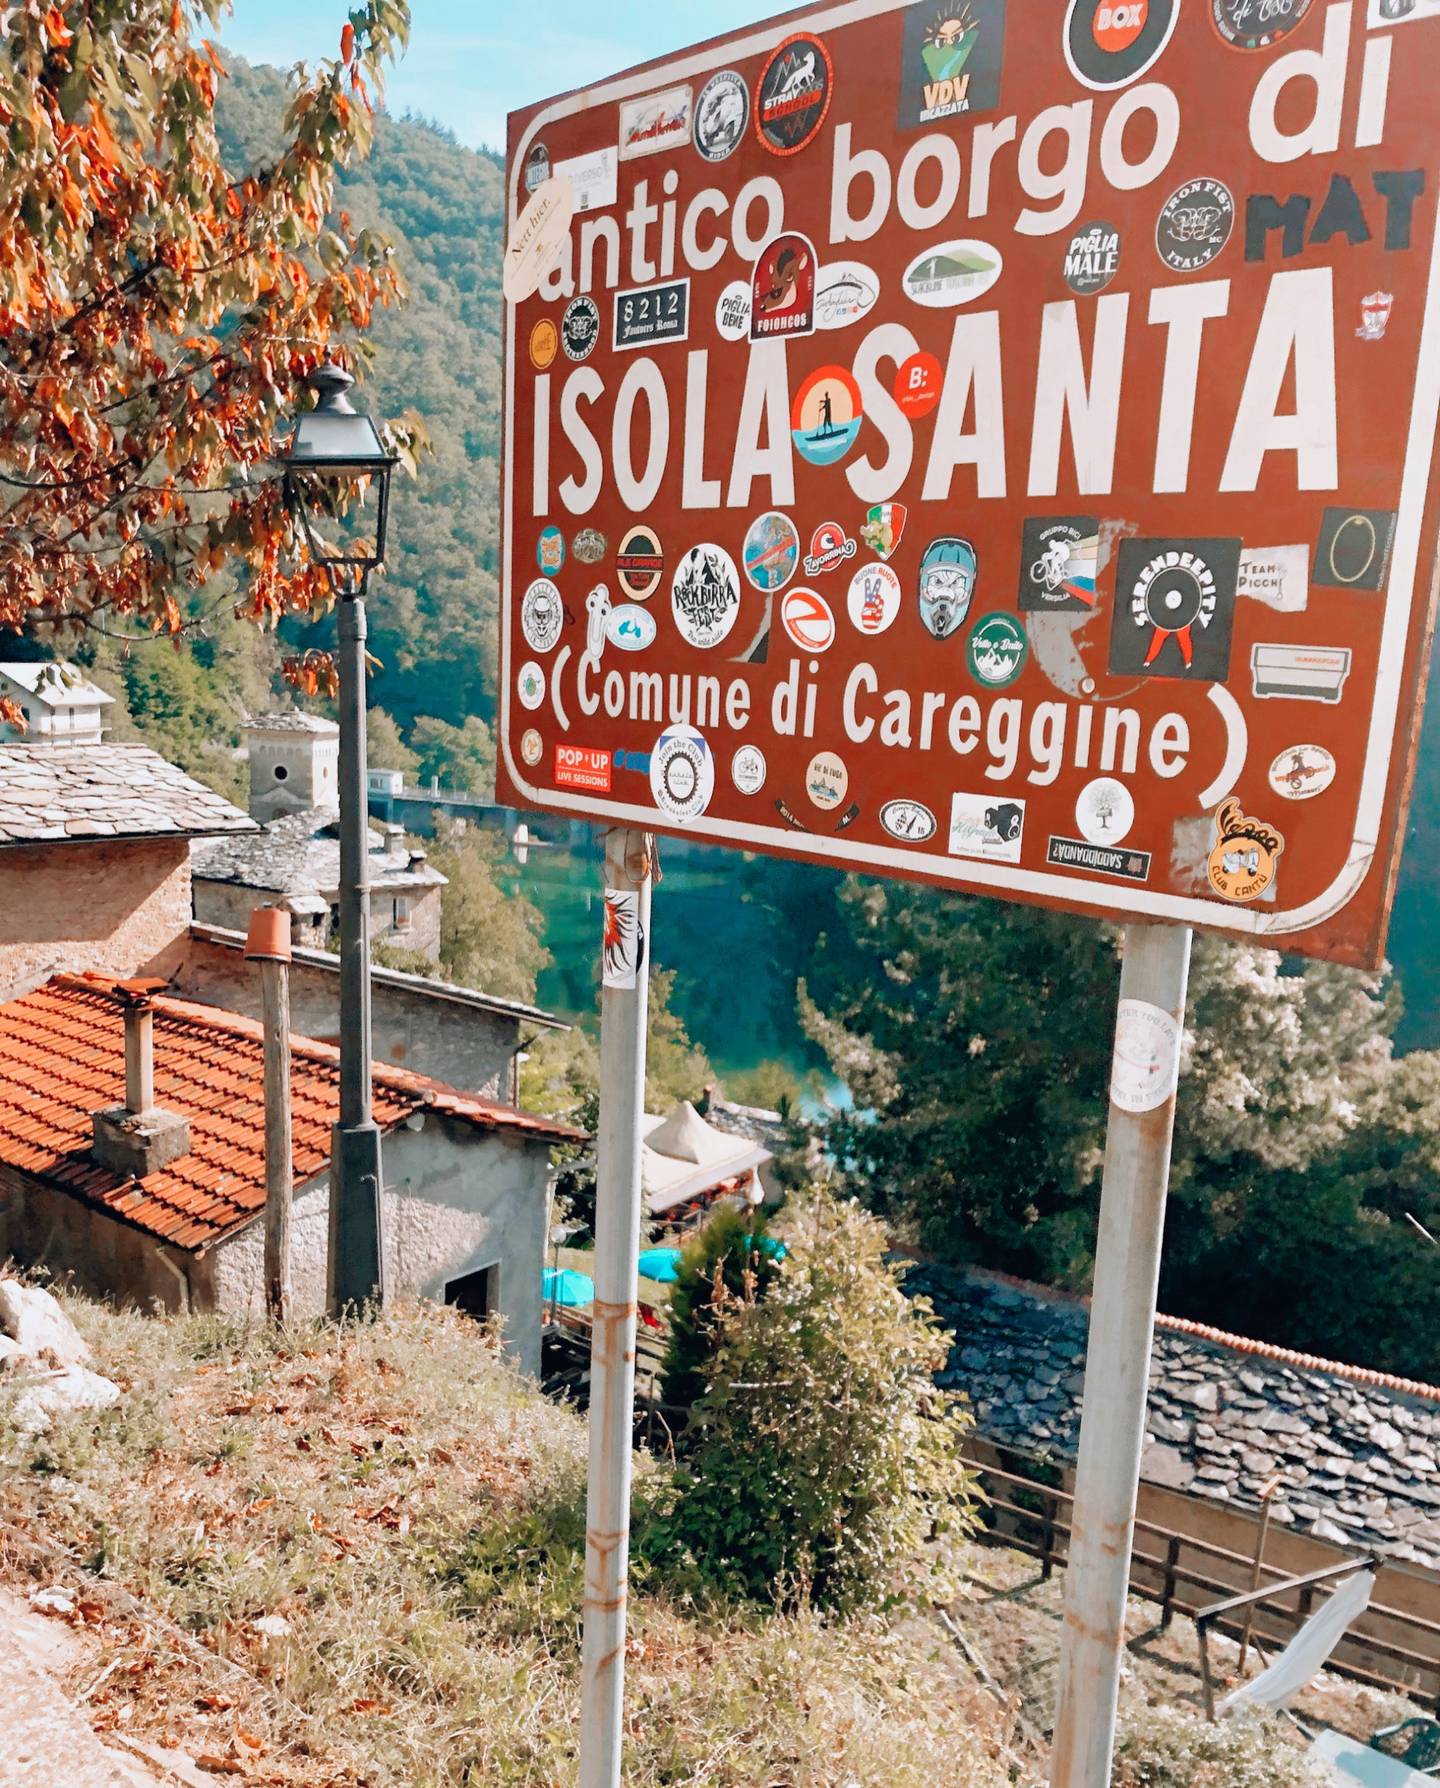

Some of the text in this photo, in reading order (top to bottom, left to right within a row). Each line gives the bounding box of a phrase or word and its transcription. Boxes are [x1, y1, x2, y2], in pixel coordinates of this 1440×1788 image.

[1097, 4, 1144, 31] BOX
[764, 91, 800, 109] STRAY
[923, 74, 970, 110] VDV
[537, 169, 785, 302] antico
[829, 82, 1180, 246] borgo
[1248, 2, 1393, 163] di
[1163, 182, 1232, 219] IRON FIST
[1244, 168, 1426, 262] MAT
[1069, 232, 1119, 255] PIGLIA
[1064, 251, 1119, 276] MALE
[1166, 248, 1213, 269] ITALY
[722, 311, 744, 330] BENE
[533, 266, 1338, 516] ISOLA SANTA
[1040, 525, 1082, 541] GRUPPO BICI
[1239, 560, 1276, 575] TEAM
[687, 607, 717, 628] FEST
[771, 658, 818, 738] di
[842, 661, 1248, 810] Careggine)
[558, 748, 583, 766] POP
[591, 752, 609, 770] UP
[658, 744, 673, 765] Join
[673, 739, 687, 749] the
[687, 743, 704, 767] Club
[557, 771, 609, 788] LIVE SESSIONS
[1212, 866, 1228, 891] CLUB
